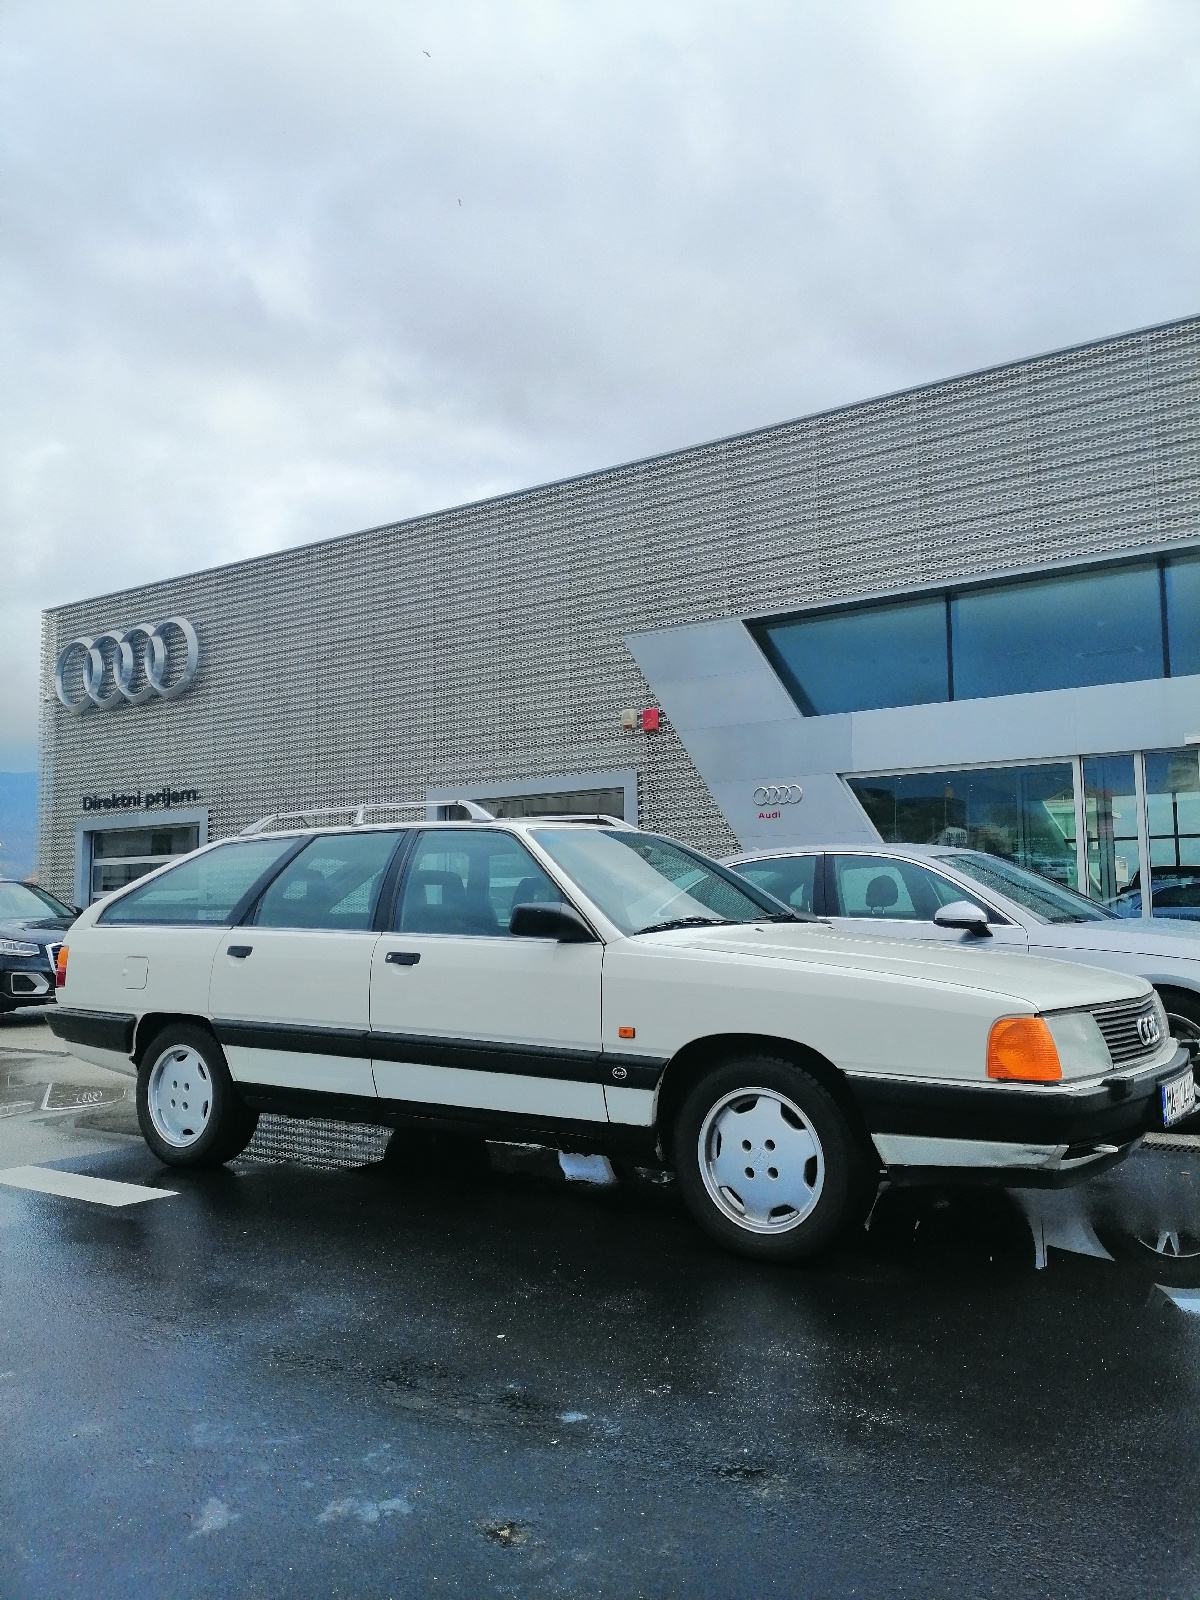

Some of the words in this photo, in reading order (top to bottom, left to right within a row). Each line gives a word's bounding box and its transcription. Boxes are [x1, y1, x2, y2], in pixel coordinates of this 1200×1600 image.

[83, 791, 141, 811] Direktni
[145, 787, 197, 809] prijem
[758, 811, 781, 819] Audi
